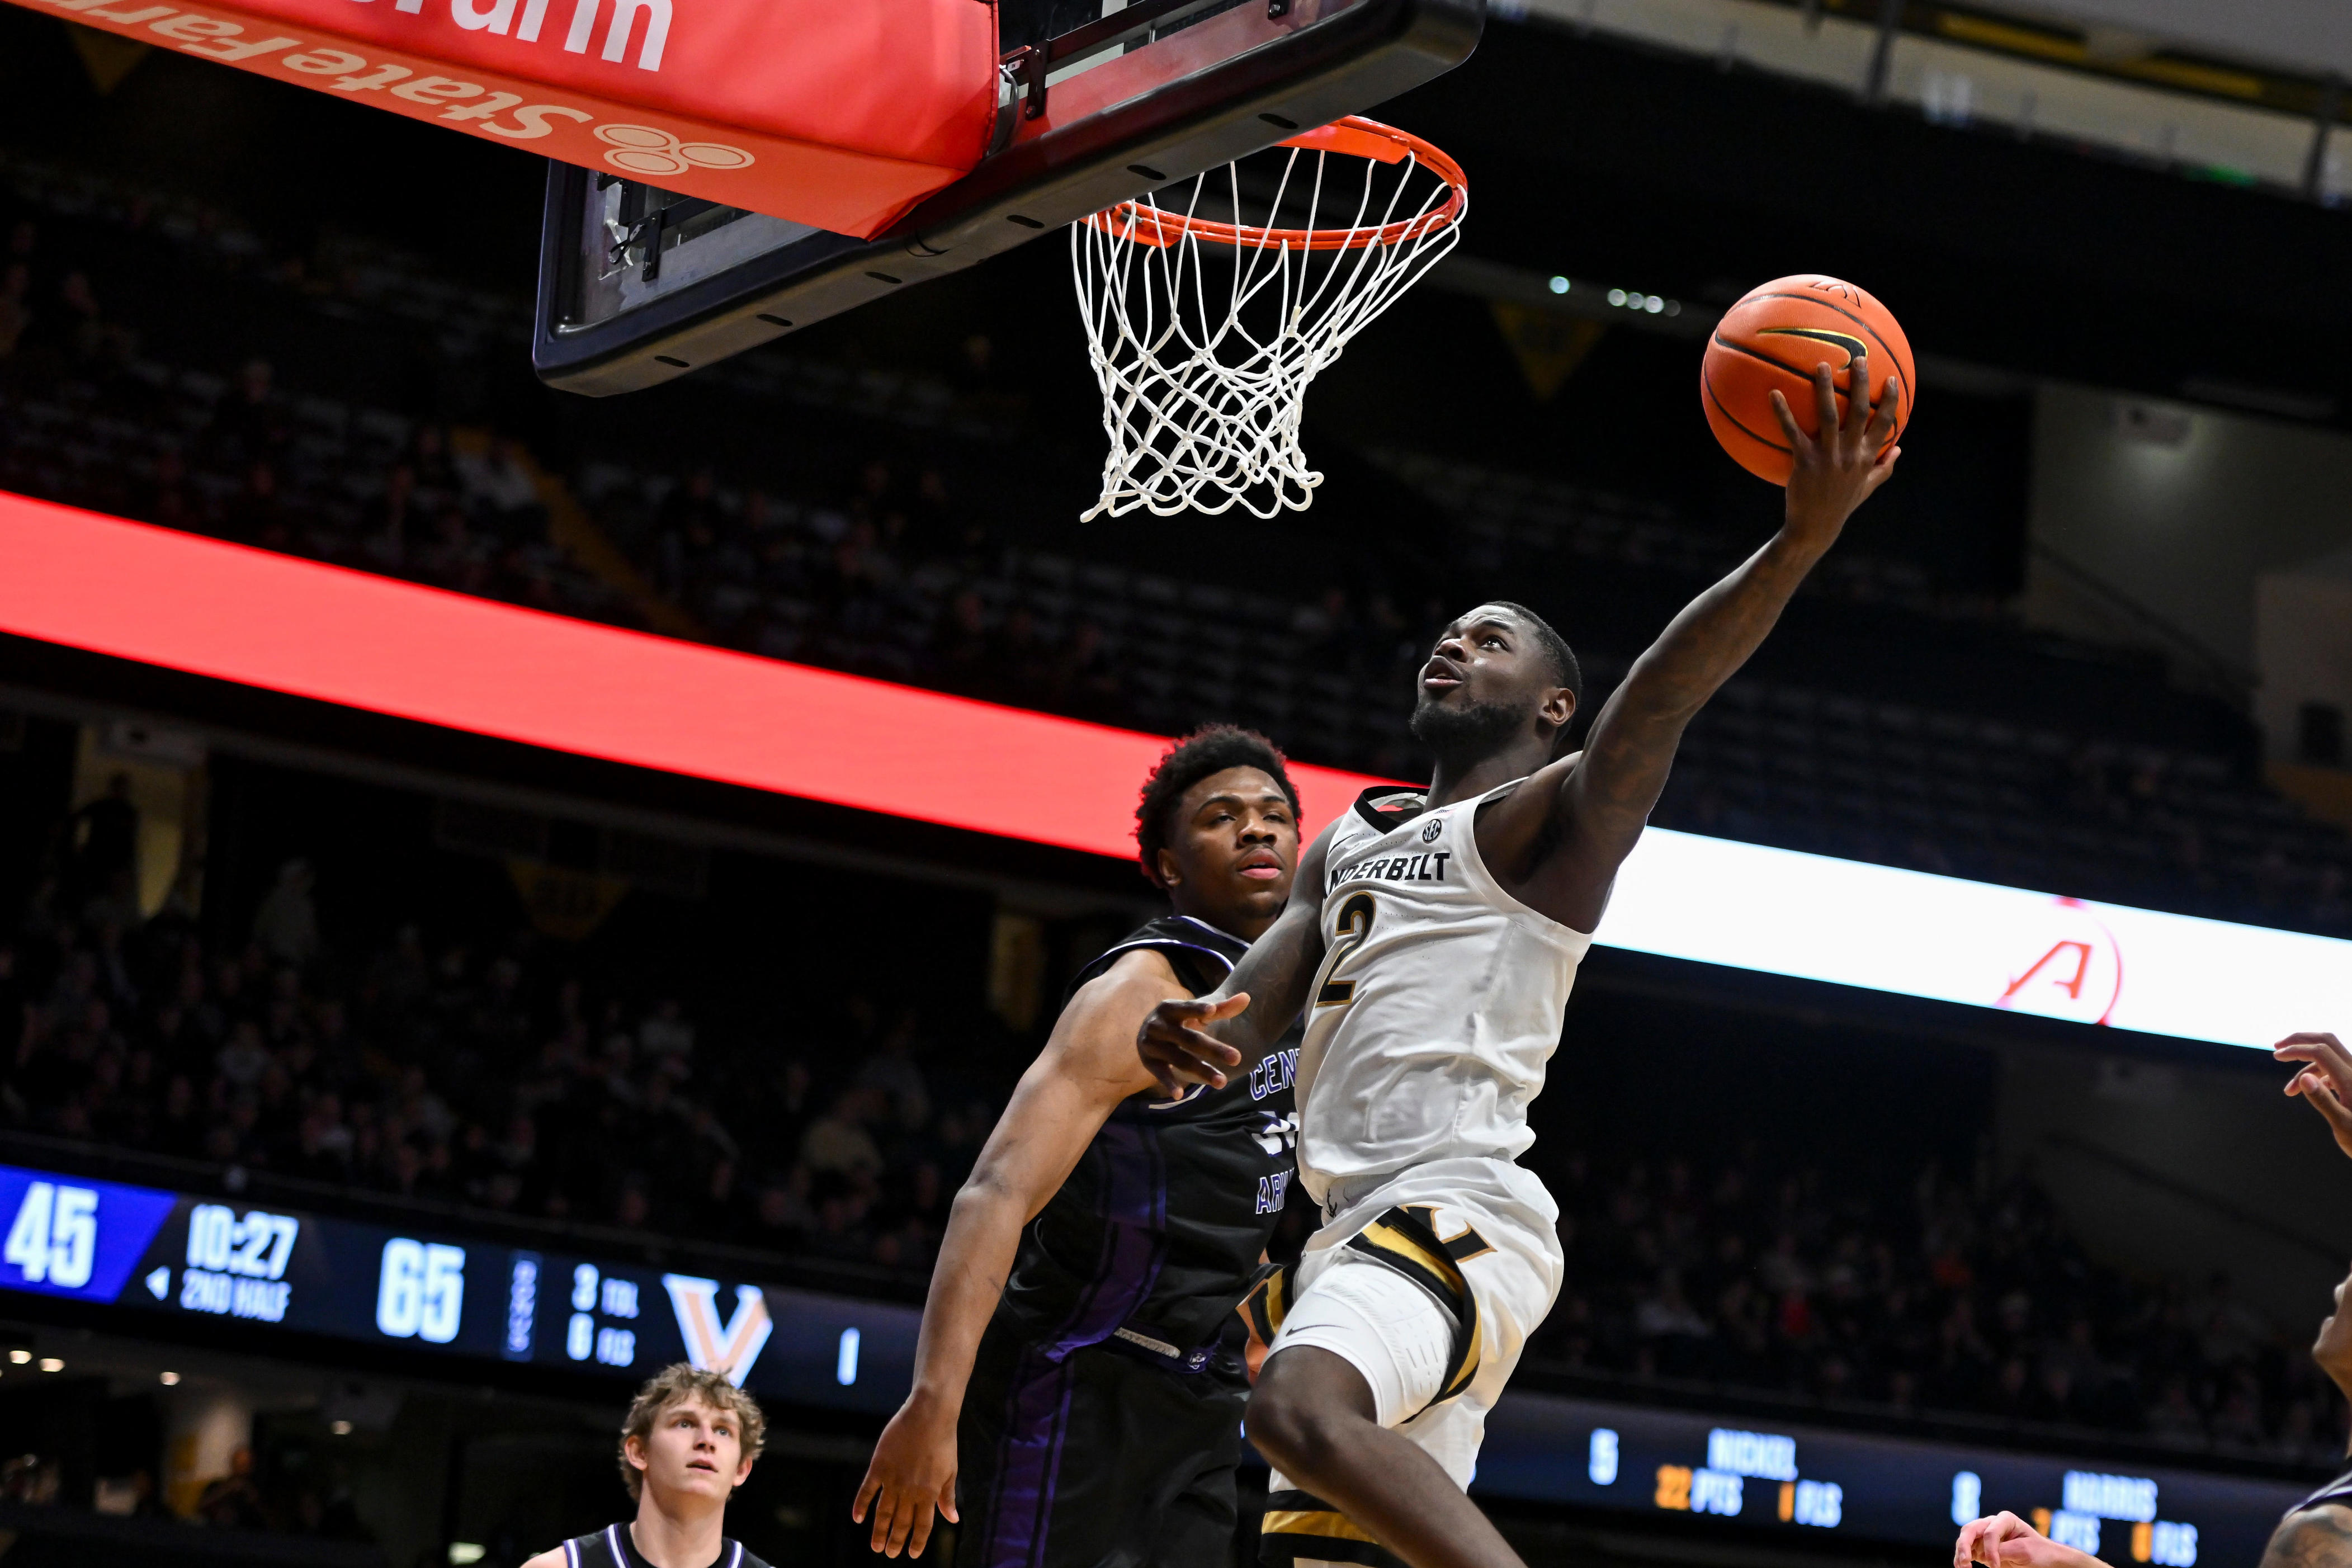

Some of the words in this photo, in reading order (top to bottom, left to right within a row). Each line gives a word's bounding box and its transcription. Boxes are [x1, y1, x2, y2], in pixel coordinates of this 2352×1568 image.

[1326, 853, 1450, 897] NDERBILT
[1423, 819, 1442, 843] SEC
[1315, 891, 1376, 1008] 2
[4, 1181, 98, 1288] 45
[186, 1203, 299, 1281] 10:27
[376, 1238, 466, 1344] 65
